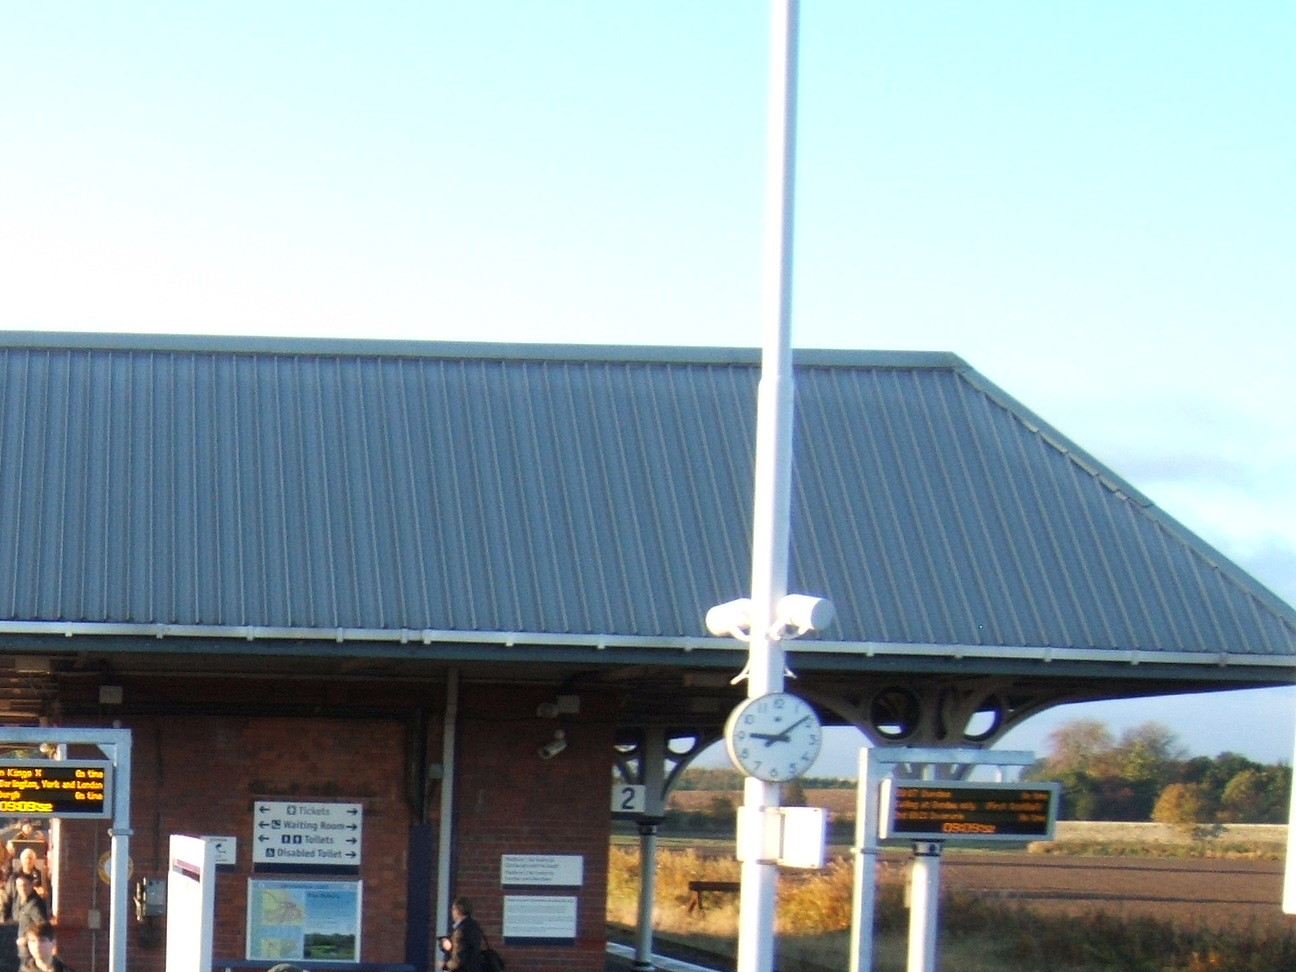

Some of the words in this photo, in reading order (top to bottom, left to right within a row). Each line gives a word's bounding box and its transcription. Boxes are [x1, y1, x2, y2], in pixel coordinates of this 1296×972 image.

[7, 768, 33, 779] Kings
[76, 780, 103, 790] London
[621, 786, 635, 810] 2
[298, 806, 330, 816] Tickets
[283, 820, 318, 832] Waiting
[320, 821, 345, 830] Room
[304, 835, 334, 845] Toilets
[277, 848, 316, 858] Disabled
[317, 849, 343, 859] Toilet
